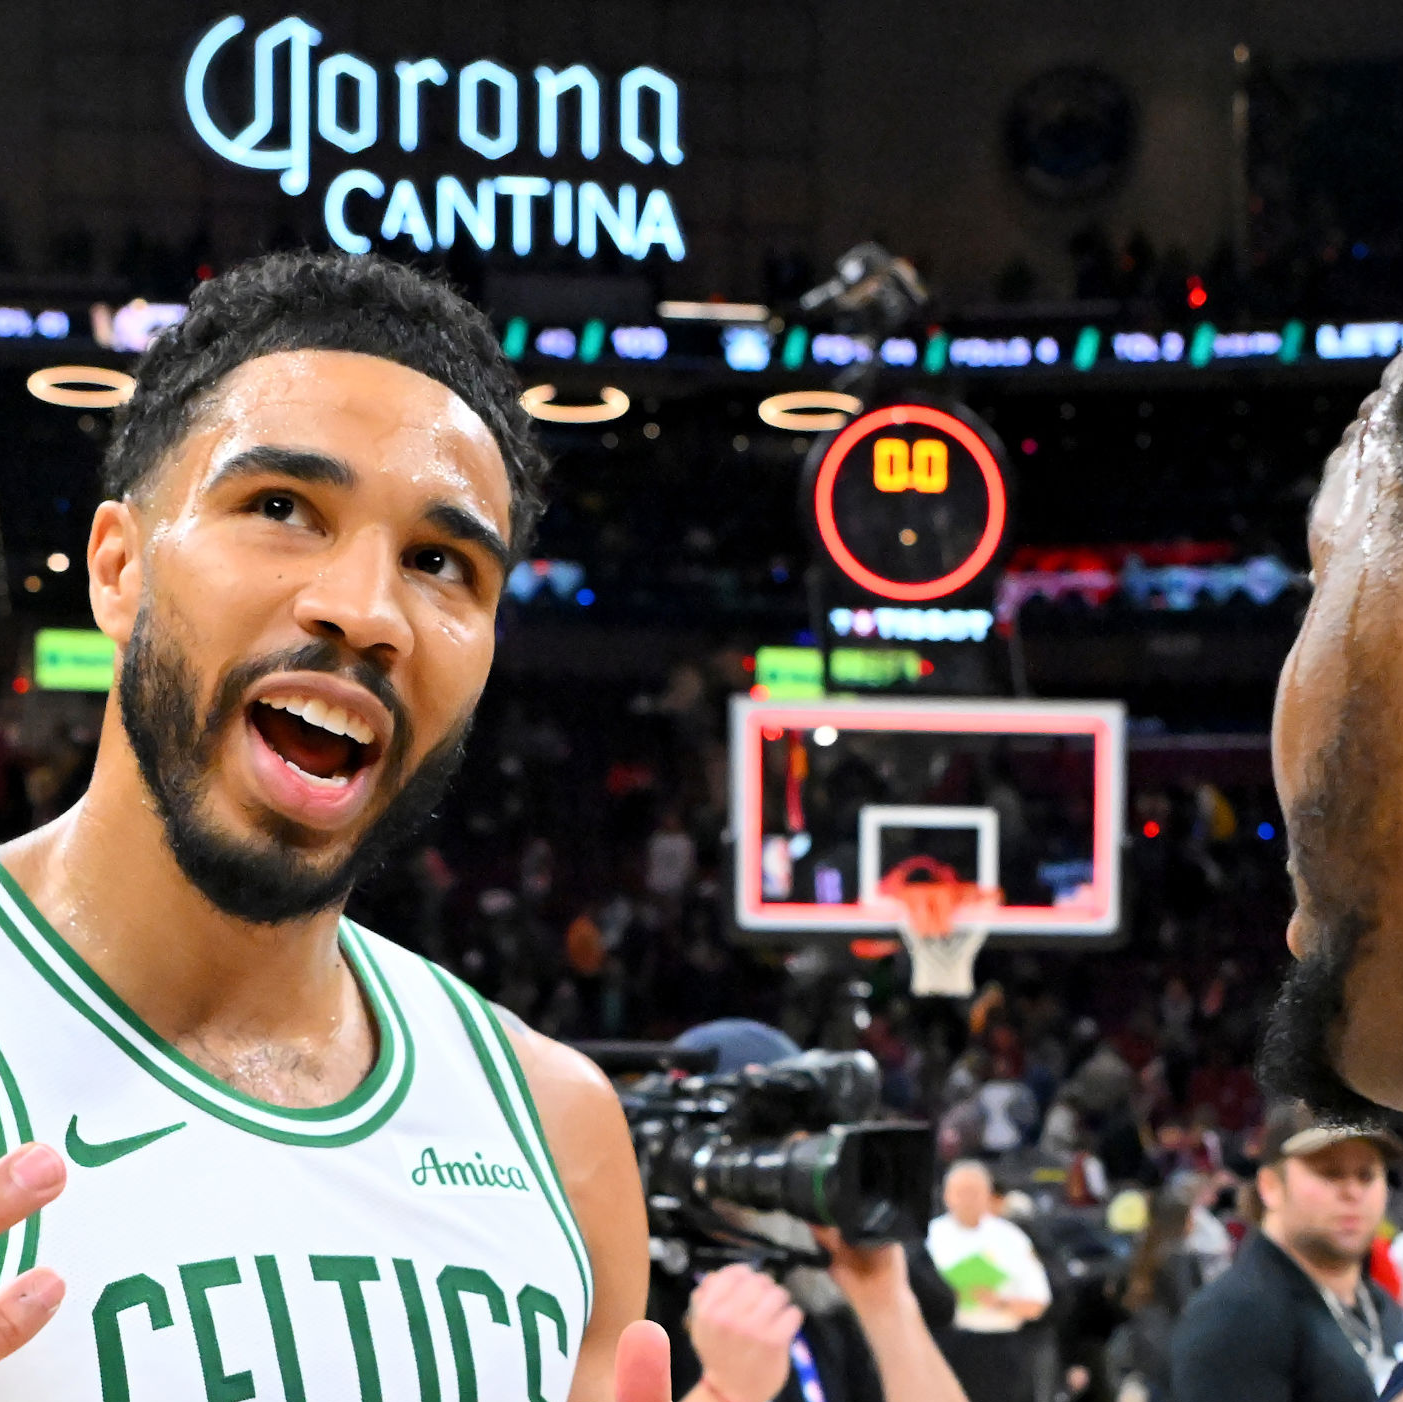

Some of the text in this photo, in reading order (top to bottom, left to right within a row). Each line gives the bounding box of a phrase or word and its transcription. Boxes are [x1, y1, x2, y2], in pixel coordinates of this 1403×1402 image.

[184, 14, 685, 197] Corona
[323, 168, 686, 262] CANTINA
[411, 1146, 530, 1192] Amica
